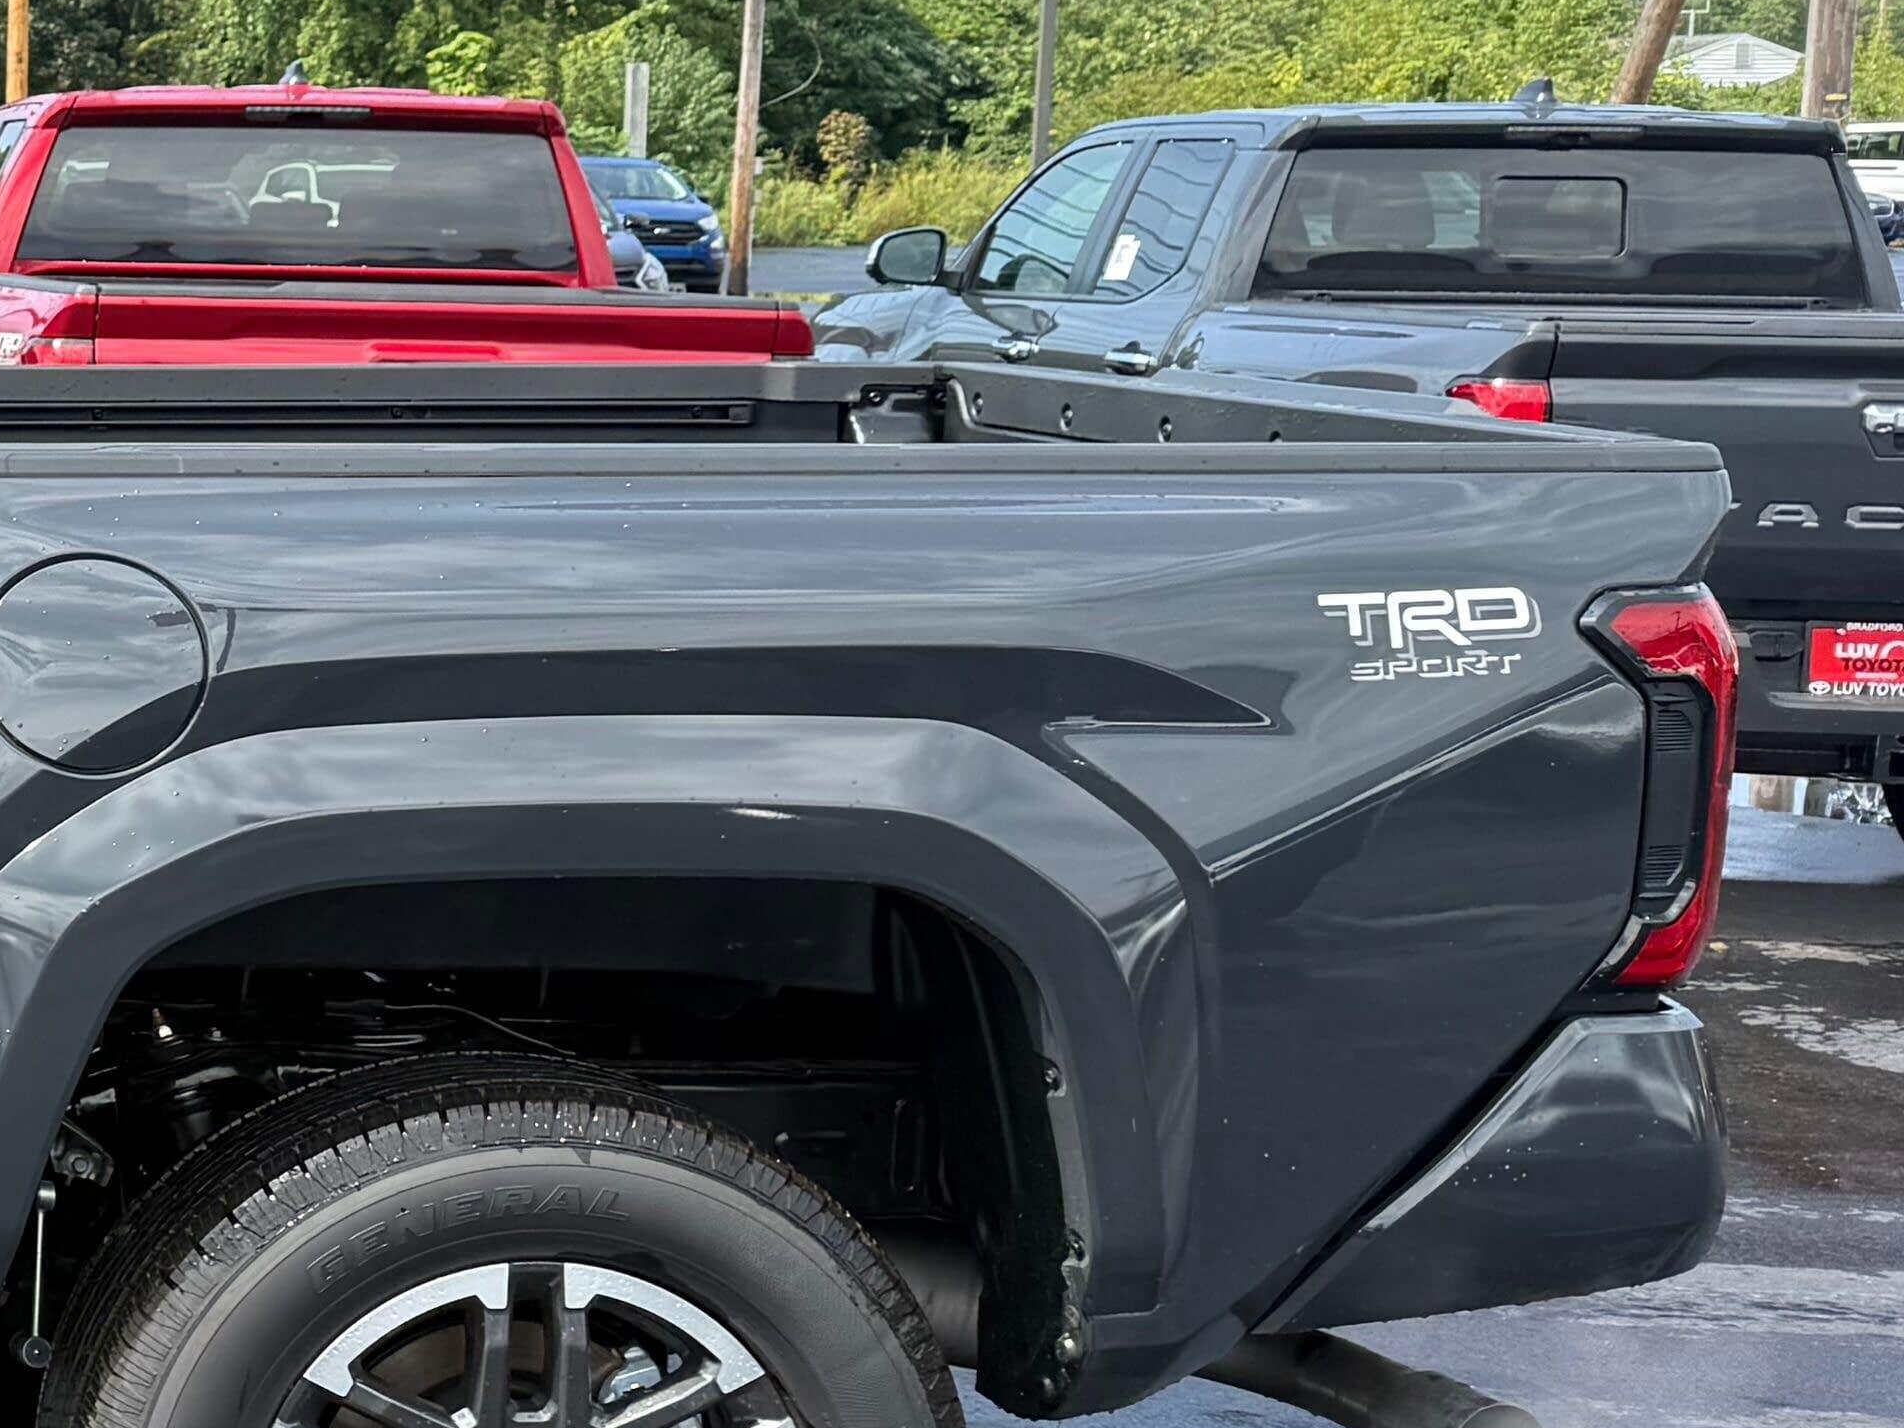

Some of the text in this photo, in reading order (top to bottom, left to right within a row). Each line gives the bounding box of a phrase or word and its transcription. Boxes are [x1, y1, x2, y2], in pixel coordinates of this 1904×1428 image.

[1729, 501, 1904, 530] AC
[1317, 586, 1542, 656] TRD
[1835, 642, 1879, 659] LUV
[1350, 653, 1522, 682] SPORT
[1841, 658, 1904, 673] TOYOT
[1833, 681, 1864, 696] LUV
[304, 1183, 631, 1295] GENERAL
